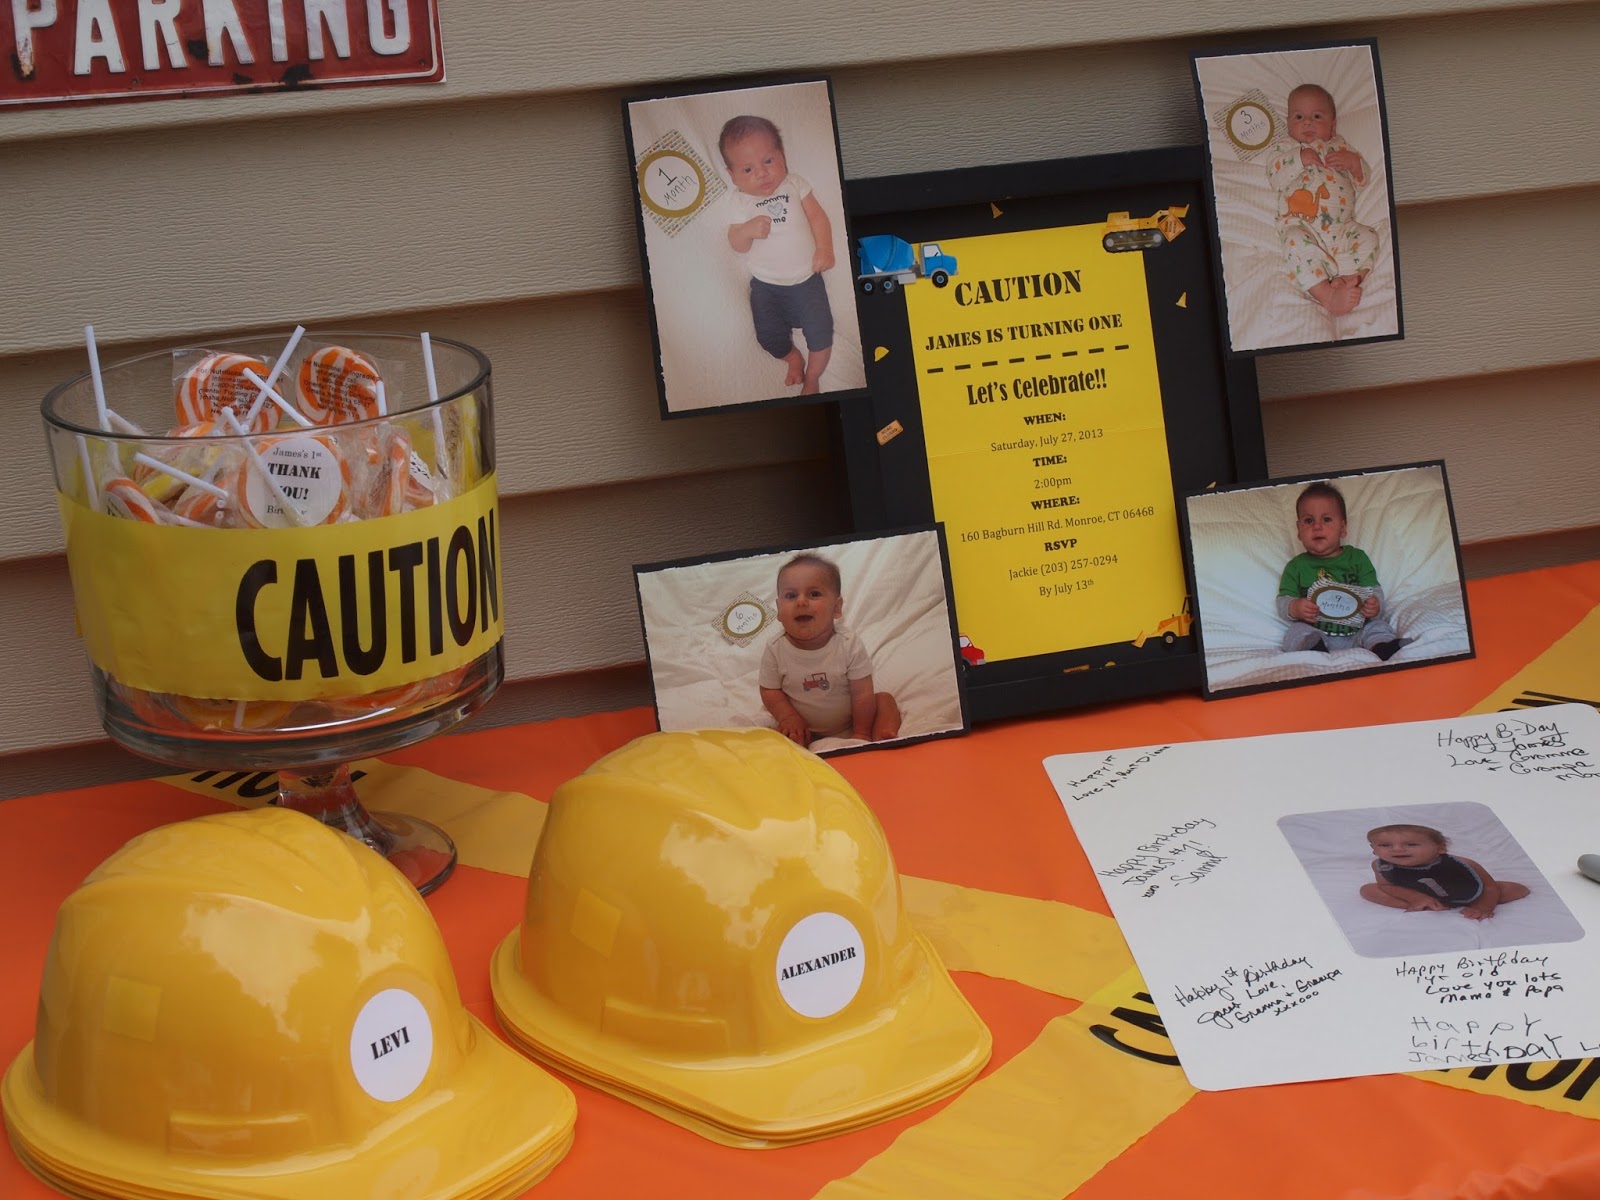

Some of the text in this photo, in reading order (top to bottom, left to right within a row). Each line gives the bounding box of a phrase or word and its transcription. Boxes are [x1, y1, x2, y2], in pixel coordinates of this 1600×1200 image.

[13, 0, 410, 76] PARKING
[658, 167, 678, 186] 1
[755, 193, 790, 209] mommy
[772, 216, 787, 224] me
[954, 269, 1083, 307] CAUTION
[925, 313, 1123, 351] JAMES IS TURNING ONE
[966, 367, 1108, 406] Let's Celebrate!!
[1023, 412, 1067, 426] WHEN:
[990, 428, 1104, 453] Saturday, July 27, 2013
[267, 462, 322, 479] THANK
[1032, 454, 1068, 468] TIME:
[279, 485, 309, 500] OU!
[1033, 476, 1072, 489] 2:00pm
[1030, 495, 1081, 511] WHERE:
[960, 506, 1155, 543] 160 Bagburn Hill Rd. Monroe, CT 06468
[1044, 537, 1078, 552] RSVP
[1008, 554, 1119, 581] Jackie (203) 257-0294
[235, 508, 498, 683] CAUTION
[1039, 578, 1095, 598] By July 13th
[781, 946, 856, 981] ALEXANDER
[370, 1026, 410, 1060] LEVI
